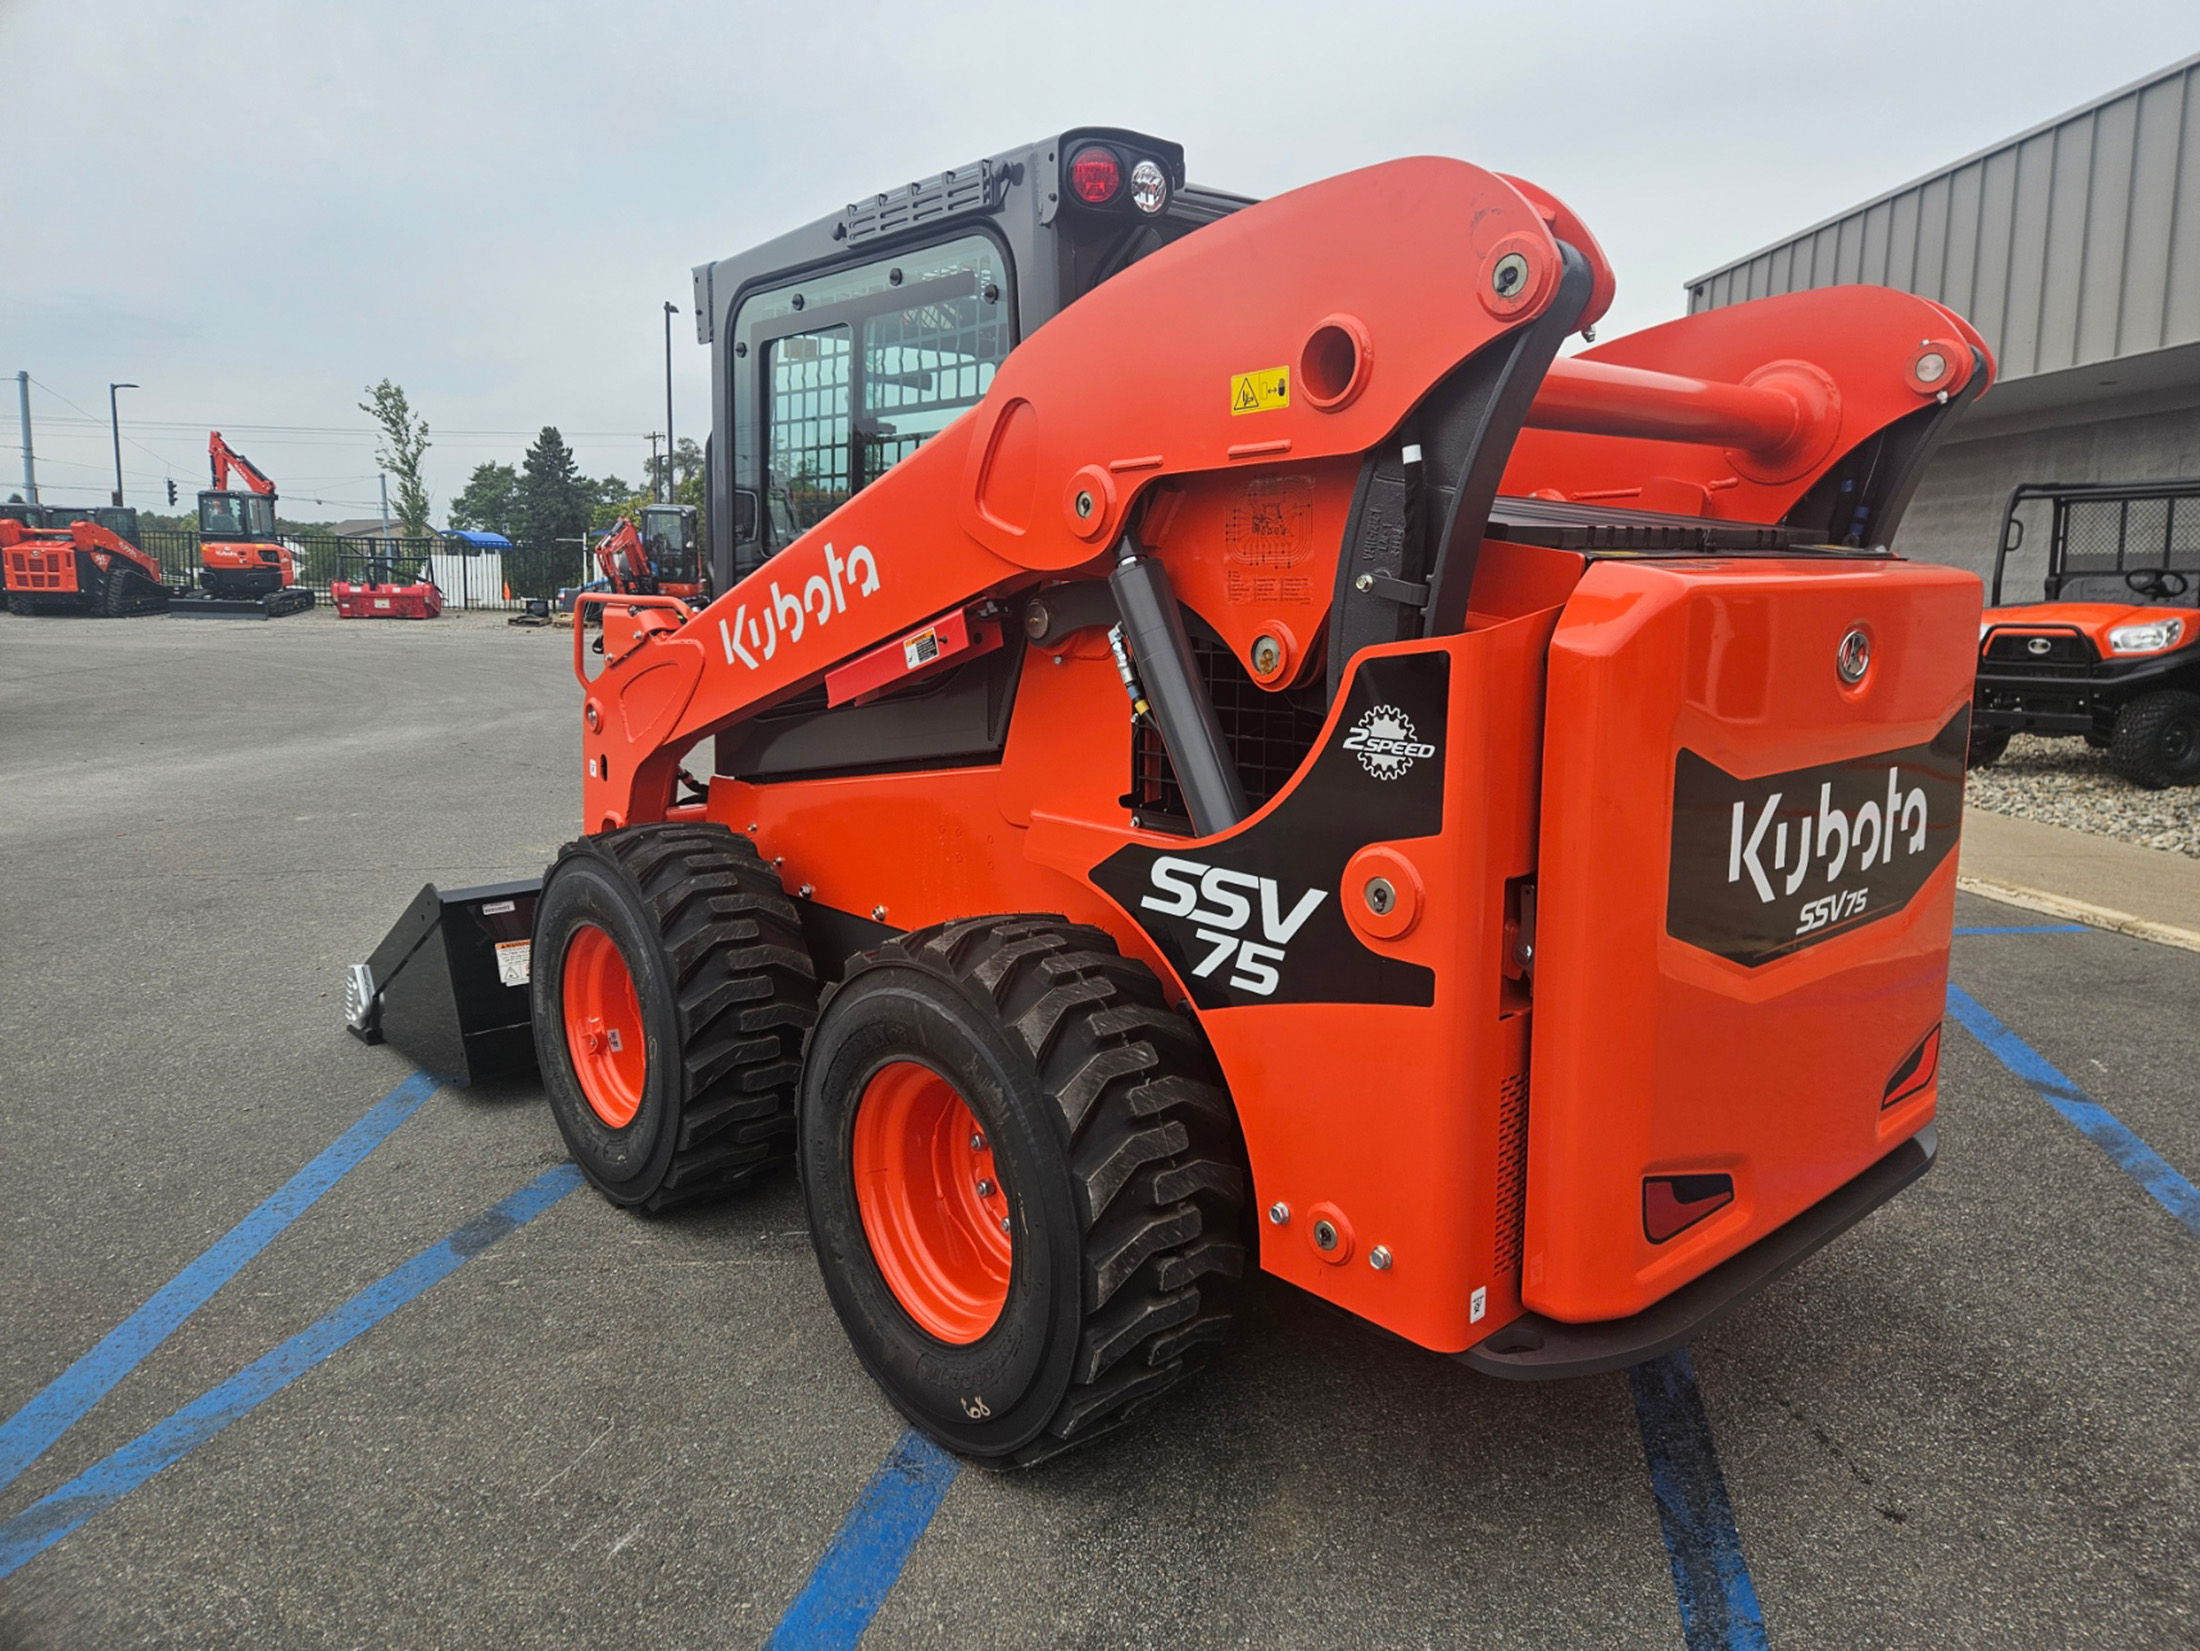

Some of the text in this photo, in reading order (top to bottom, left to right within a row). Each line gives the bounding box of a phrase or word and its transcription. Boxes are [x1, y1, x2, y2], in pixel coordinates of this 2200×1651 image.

[719, 542, 880, 670] Kubota
[1728, 766, 1928, 904] Kubota
[1140, 855, 1329, 945] SSV
[1191, 928, 1286, 996] 75
